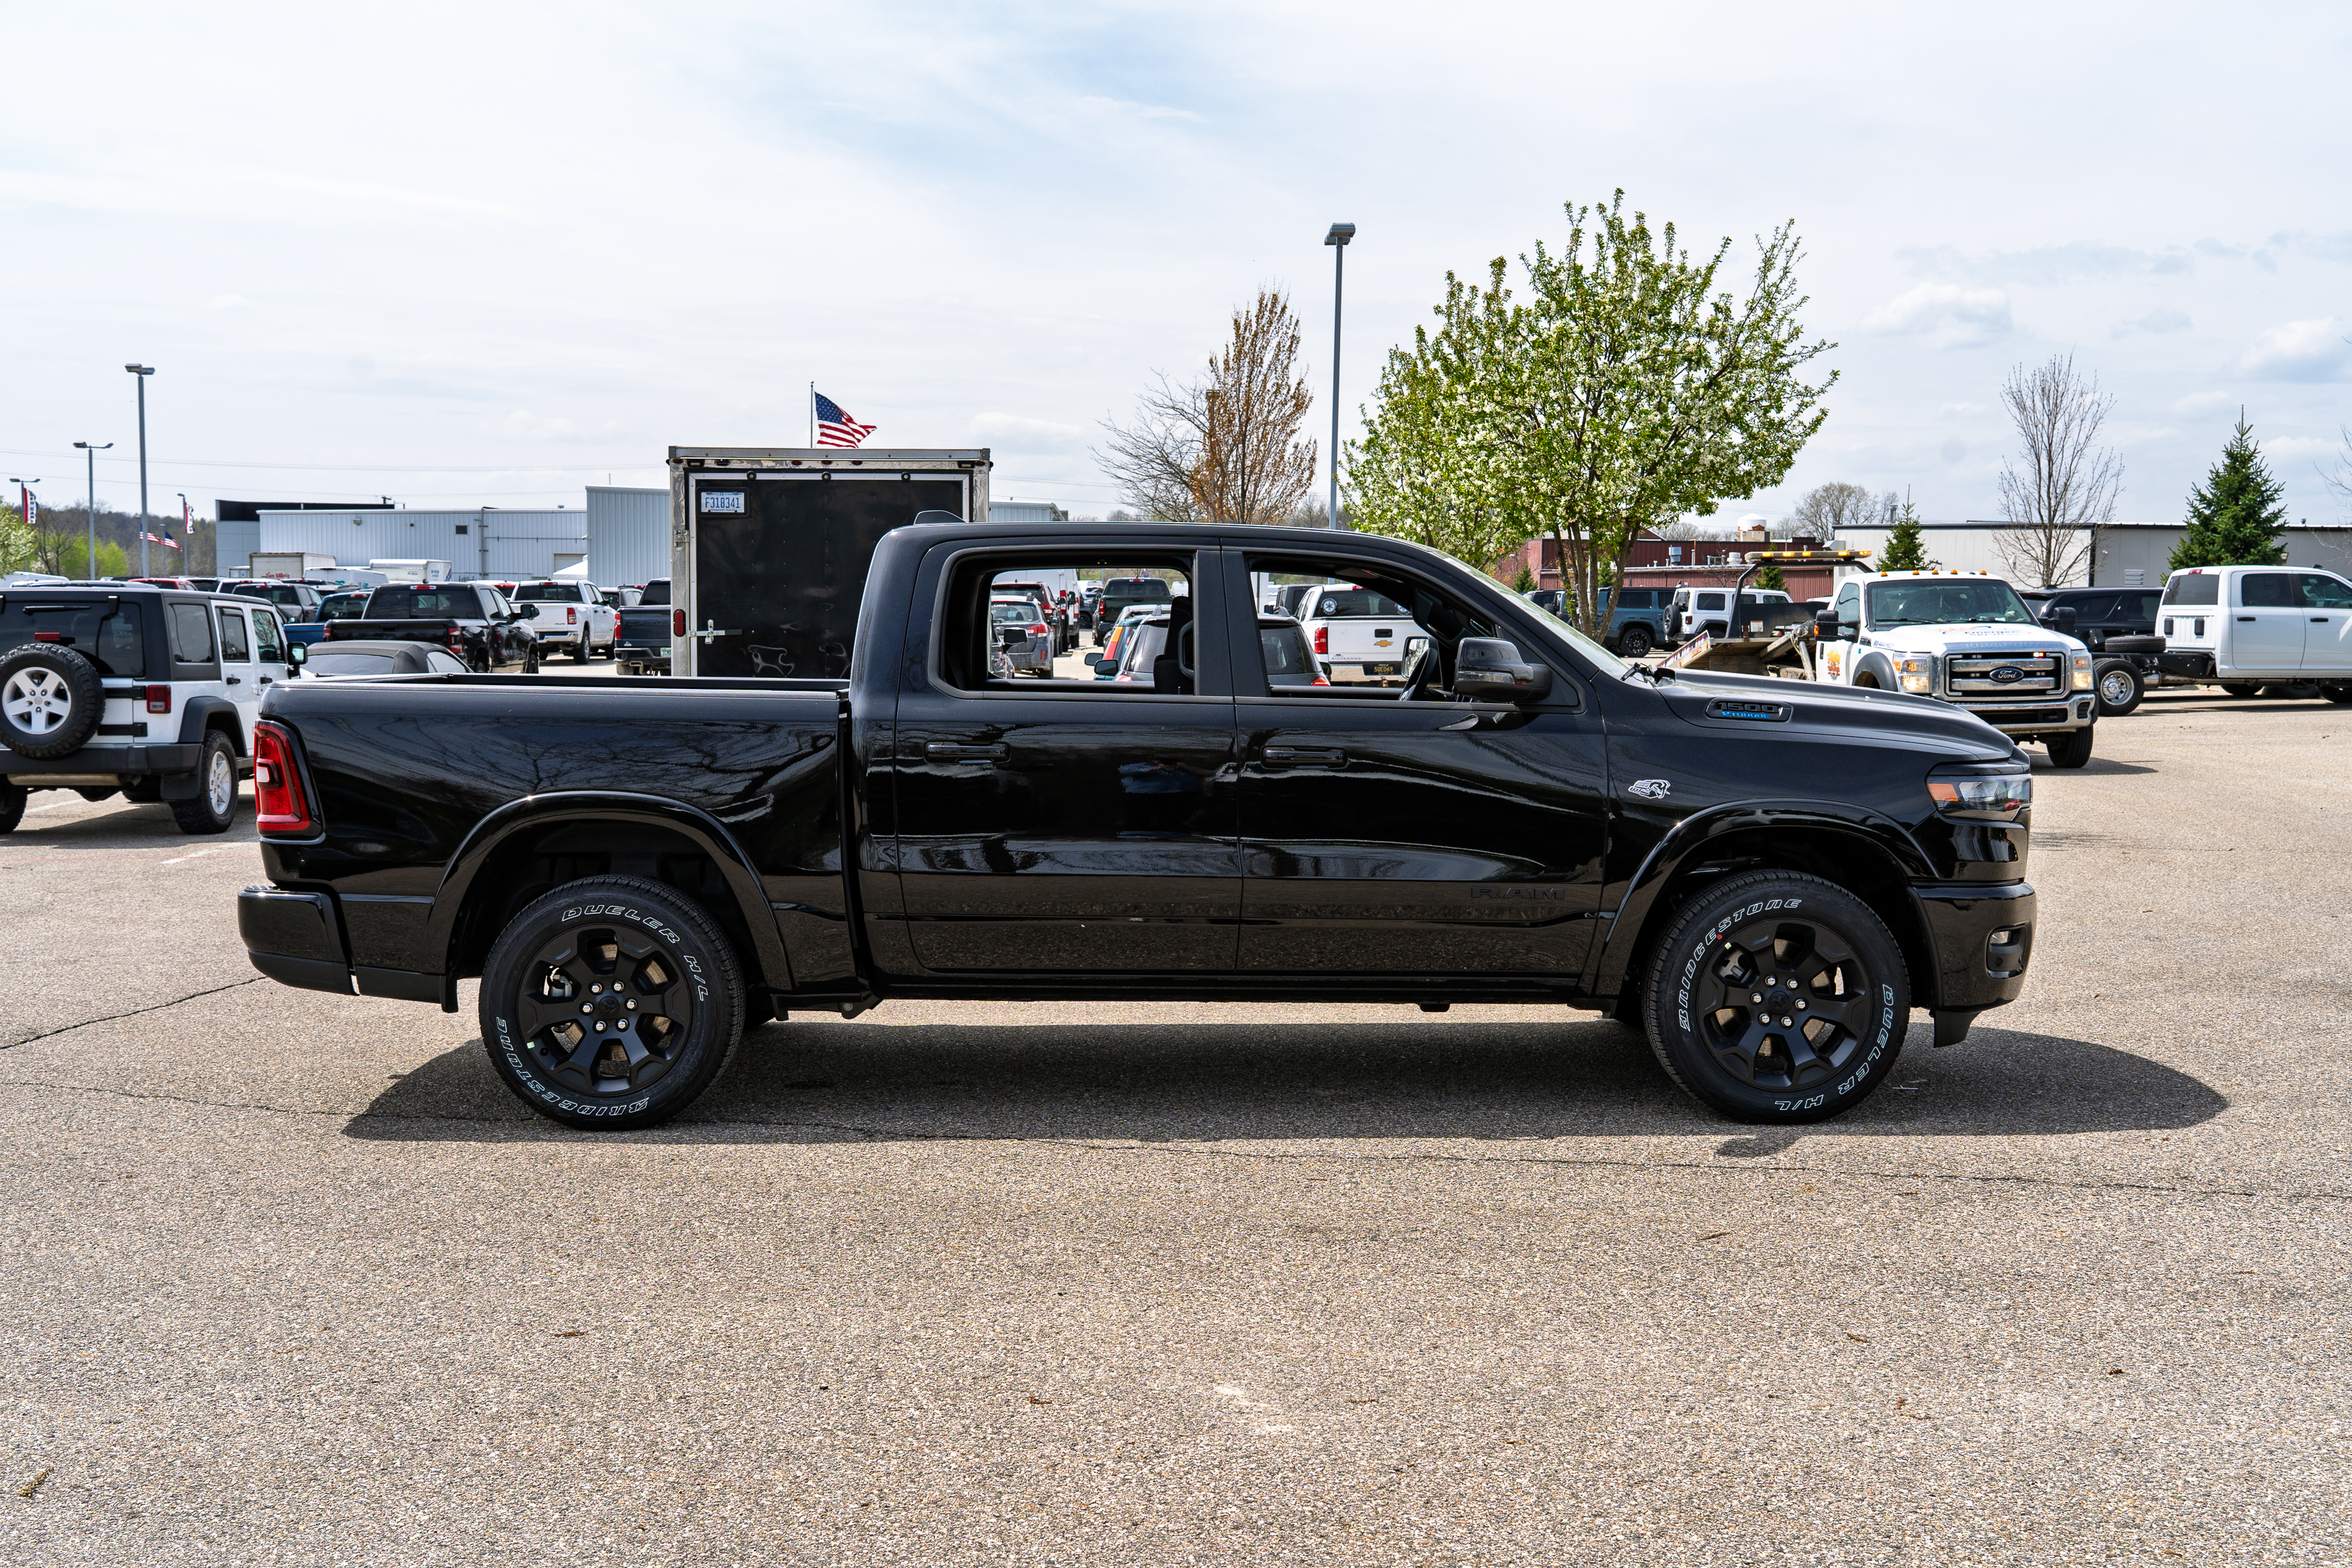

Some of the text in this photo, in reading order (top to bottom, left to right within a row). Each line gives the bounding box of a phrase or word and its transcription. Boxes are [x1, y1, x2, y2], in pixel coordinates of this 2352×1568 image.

[705, 497, 740, 509] F318341
[1998, 670, 2017, 679] Ford
[1719, 702, 1779, 712] 1500
[1471, 886, 1565, 899] RAM
[561, 905, 710, 1002] DUELER H/L
[1678, 899, 1802, 1033] BRIDGESTONE
[495, 1016, 650, 1116] BRIDGESTONE
[1774, 984, 1894, 1111] DUELER H/L
